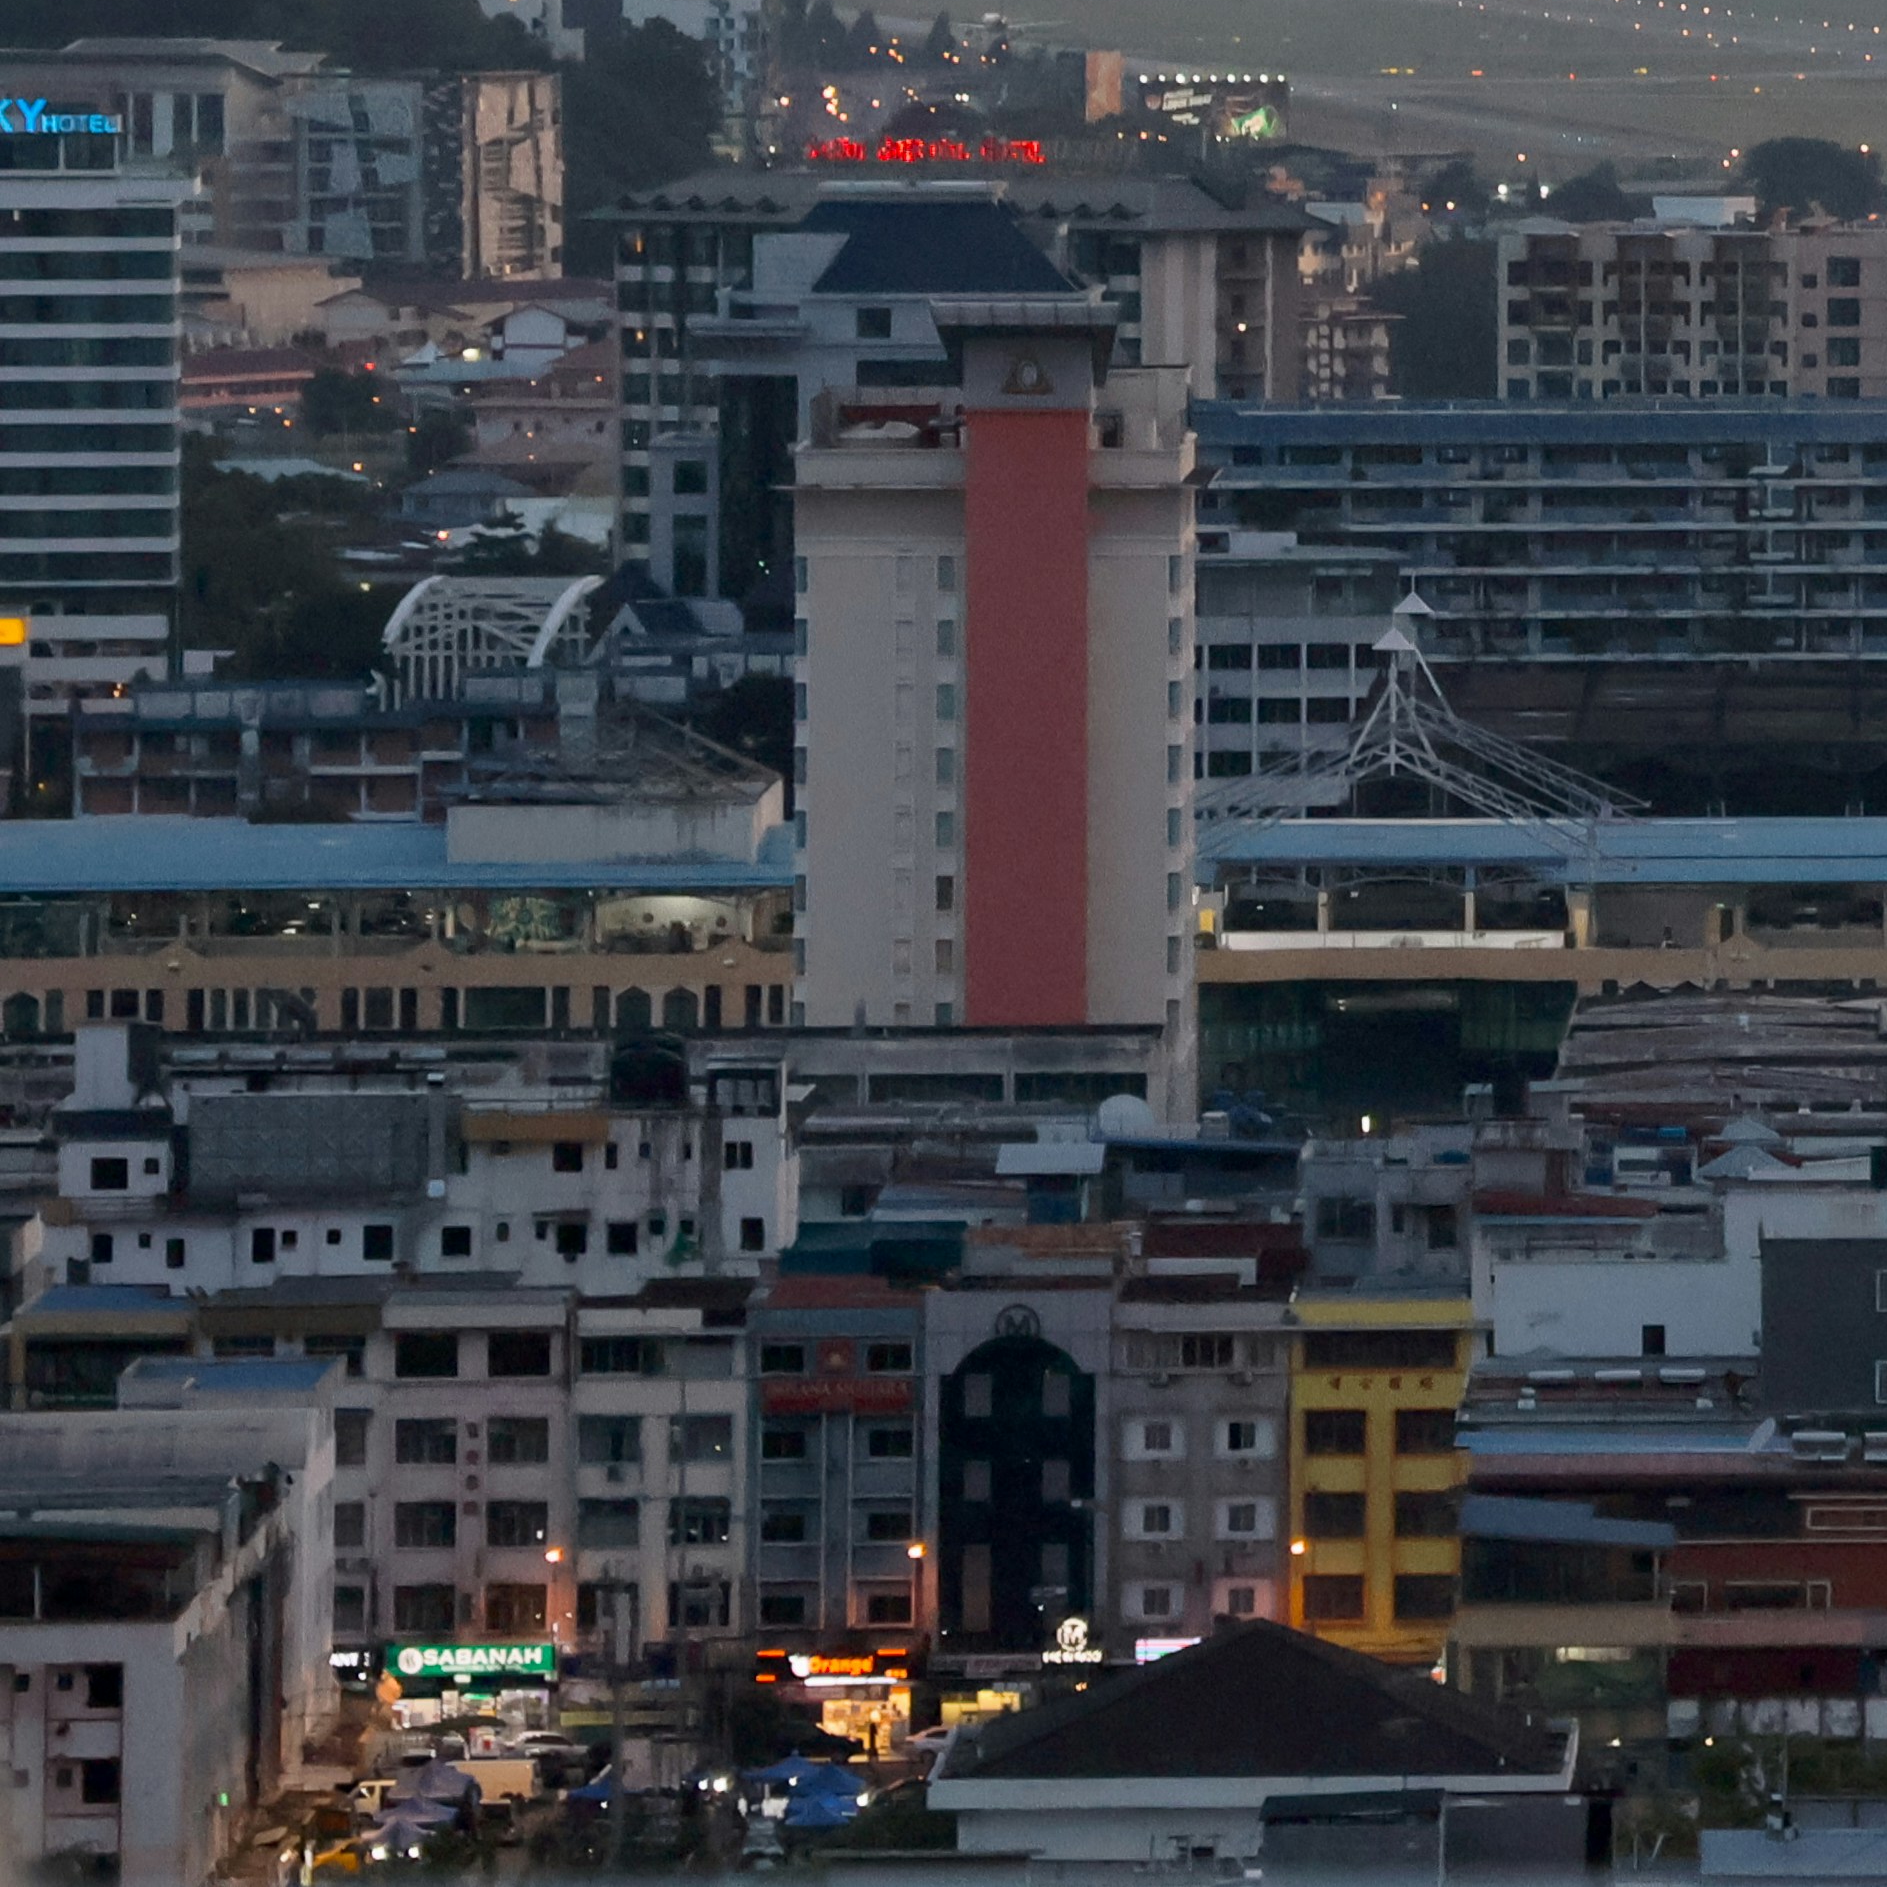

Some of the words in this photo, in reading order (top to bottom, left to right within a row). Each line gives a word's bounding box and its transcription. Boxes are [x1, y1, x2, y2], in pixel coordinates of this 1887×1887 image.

[41, 114, 117, 133] HOTEL
[422, 1647, 542, 1666] SABANAH
[809, 1655, 874, 1676] Orange
